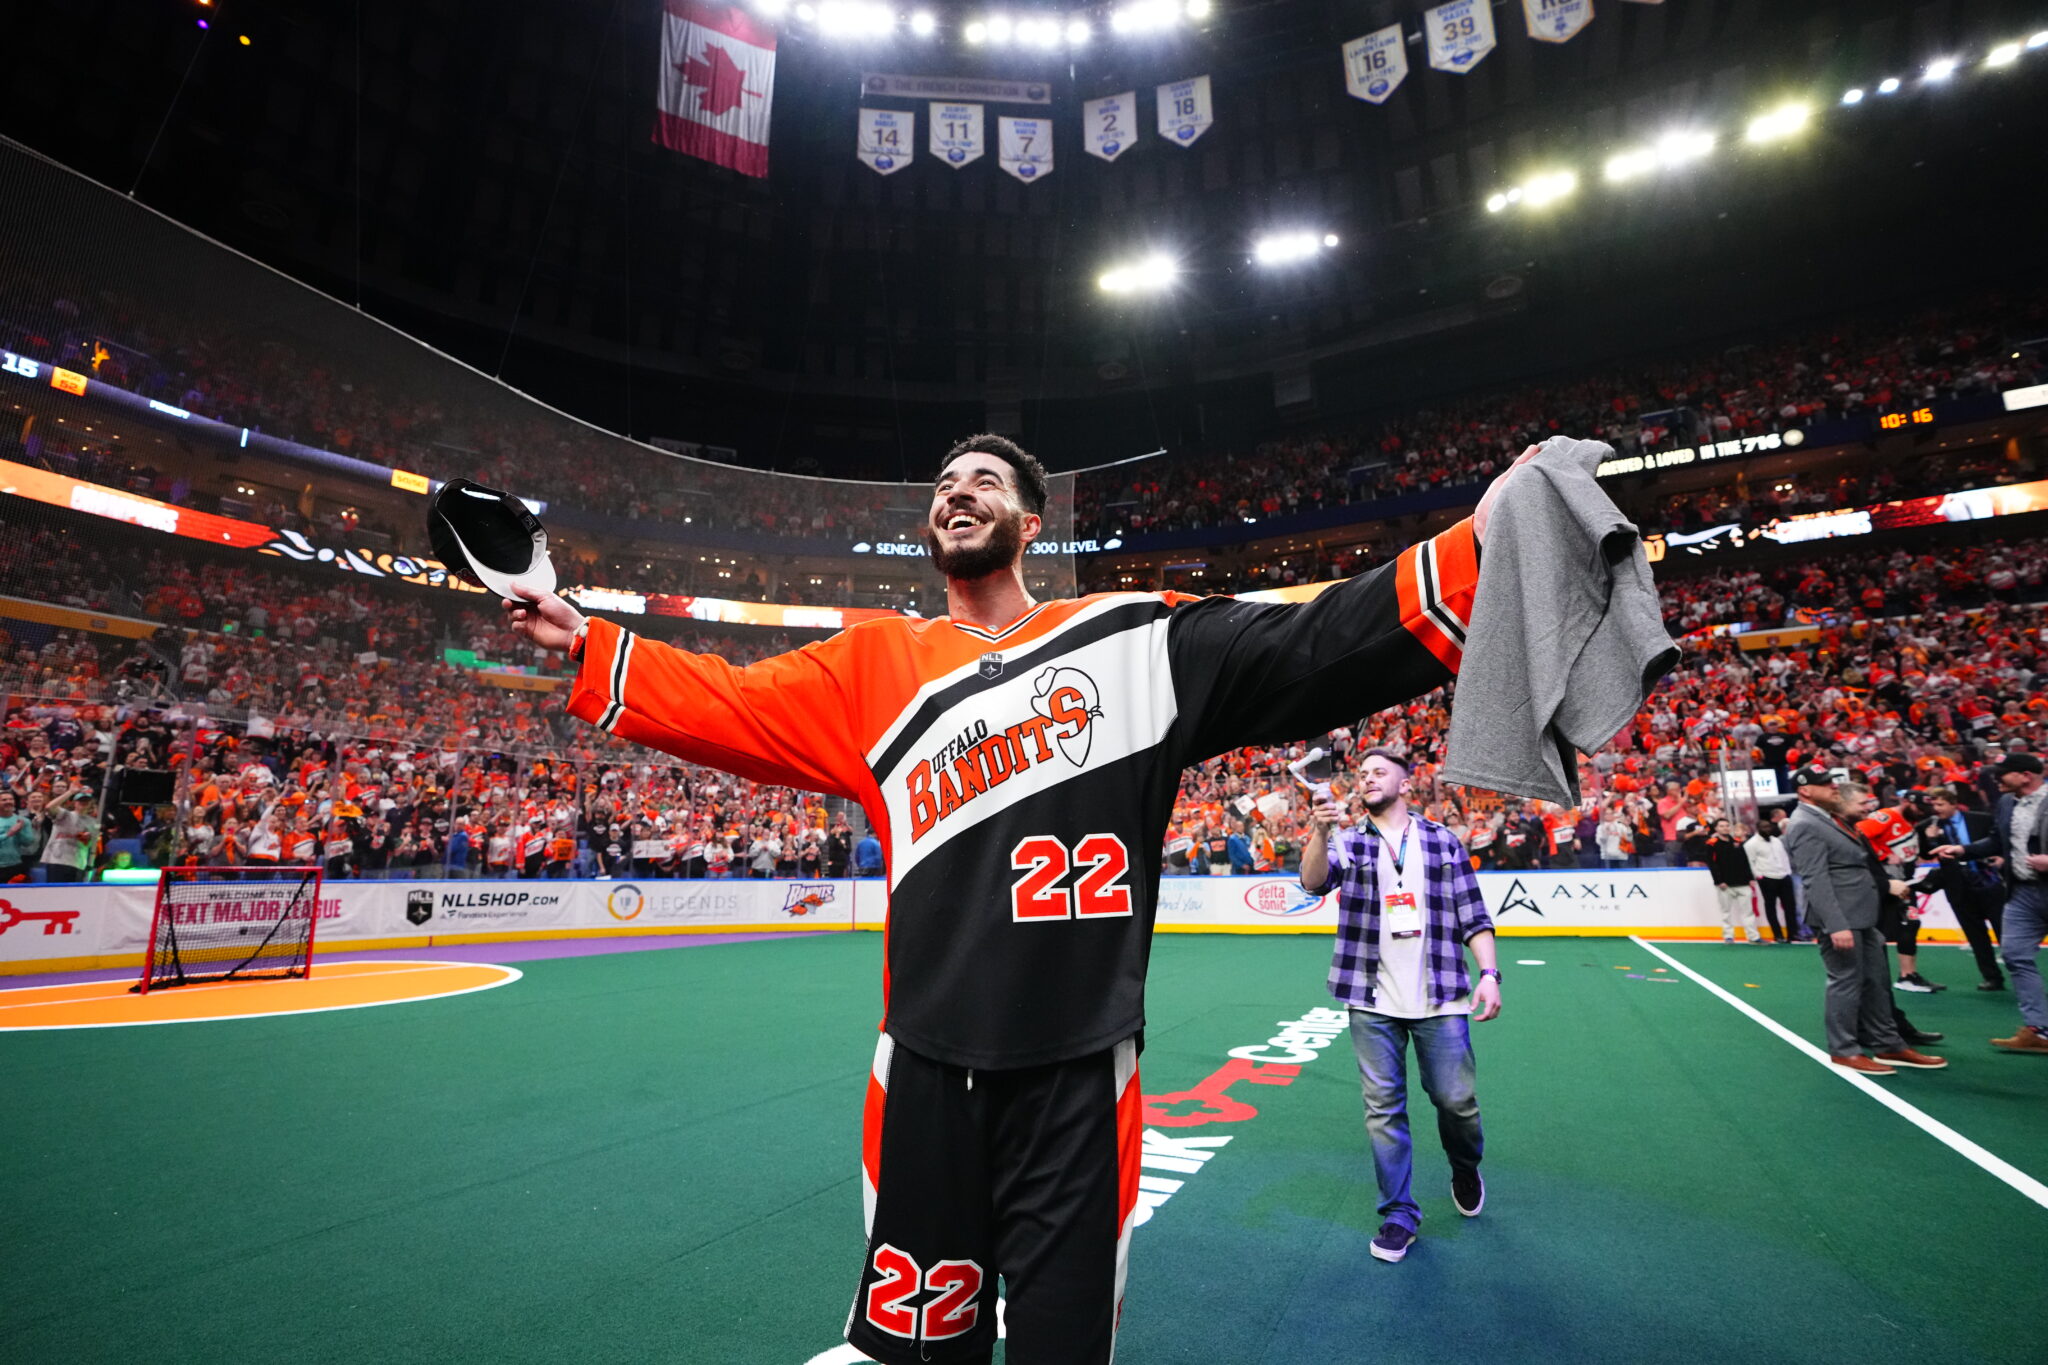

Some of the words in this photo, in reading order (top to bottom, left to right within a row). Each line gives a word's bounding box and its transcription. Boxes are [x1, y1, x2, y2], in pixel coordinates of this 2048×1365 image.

[1443, 17, 1475, 41] 39
[1363, 49, 1386, 73] 16
[1174, 97, 1195, 117] 18
[945, 121, 969, 140] 11
[1103, 114, 1117, 132] 2
[873, 128, 899, 147] 14
[1019, 136, 1034, 154] 7
[2, 352, 40, 379] 15
[1656, 447, 1696, 468] LOVED
[1717, 440, 1743, 457] THE
[1742, 432, 1783, 454] 716
[876, 542, 925, 556] SENECA
[1032, 541, 1059, 555] 300
[1062, 539, 1101, 554] LEVEL
[981, 653, 1002, 661] NLL
[905, 686, 1089, 845] BANDITS
[1010, 832, 1134, 923] 22
[209, 891, 266, 900] WELCOME
[409, 891, 434, 901] NLL
[441, 892, 559, 908] NLLSHOP.COM
[1258, 885, 1285, 899] delta
[1551, 883, 1649, 899] AXIA
[650, 895, 738, 911] LEGENDS
[1259, 899, 1287, 911] sonic
[161, 902, 211, 925] NEXT
[213, 901, 279, 922] MAJOR
[866, 1242, 984, 1341] 22
